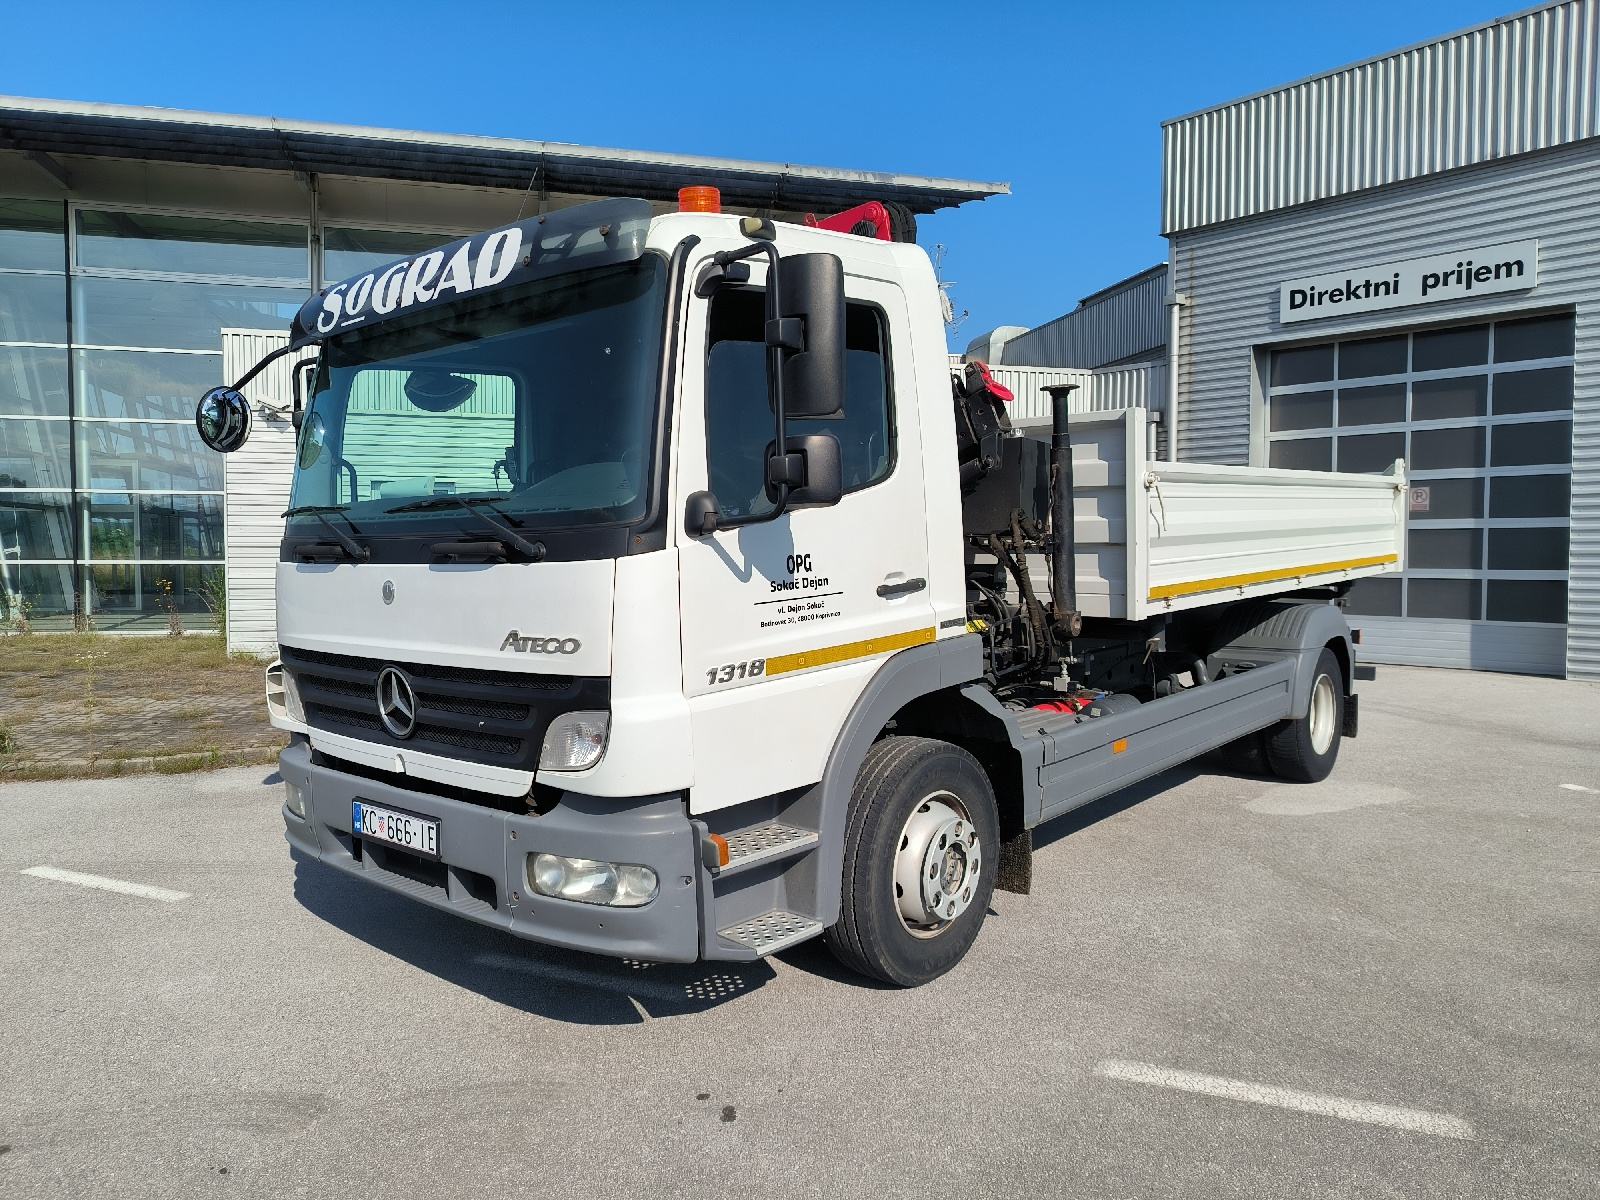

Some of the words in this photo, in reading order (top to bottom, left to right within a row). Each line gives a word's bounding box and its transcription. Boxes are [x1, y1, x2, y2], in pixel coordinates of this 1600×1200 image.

[1289, 272, 1400, 310] Direktni
[1421, 259, 1524, 296] prijem
[786, 553, 812, 575] OPG
[802, 575, 829, 591] Dejan
[500, 630, 582, 655] ATEGO
[705, 659, 766, 686] 1318
[361, 808, 377, 835] KC
